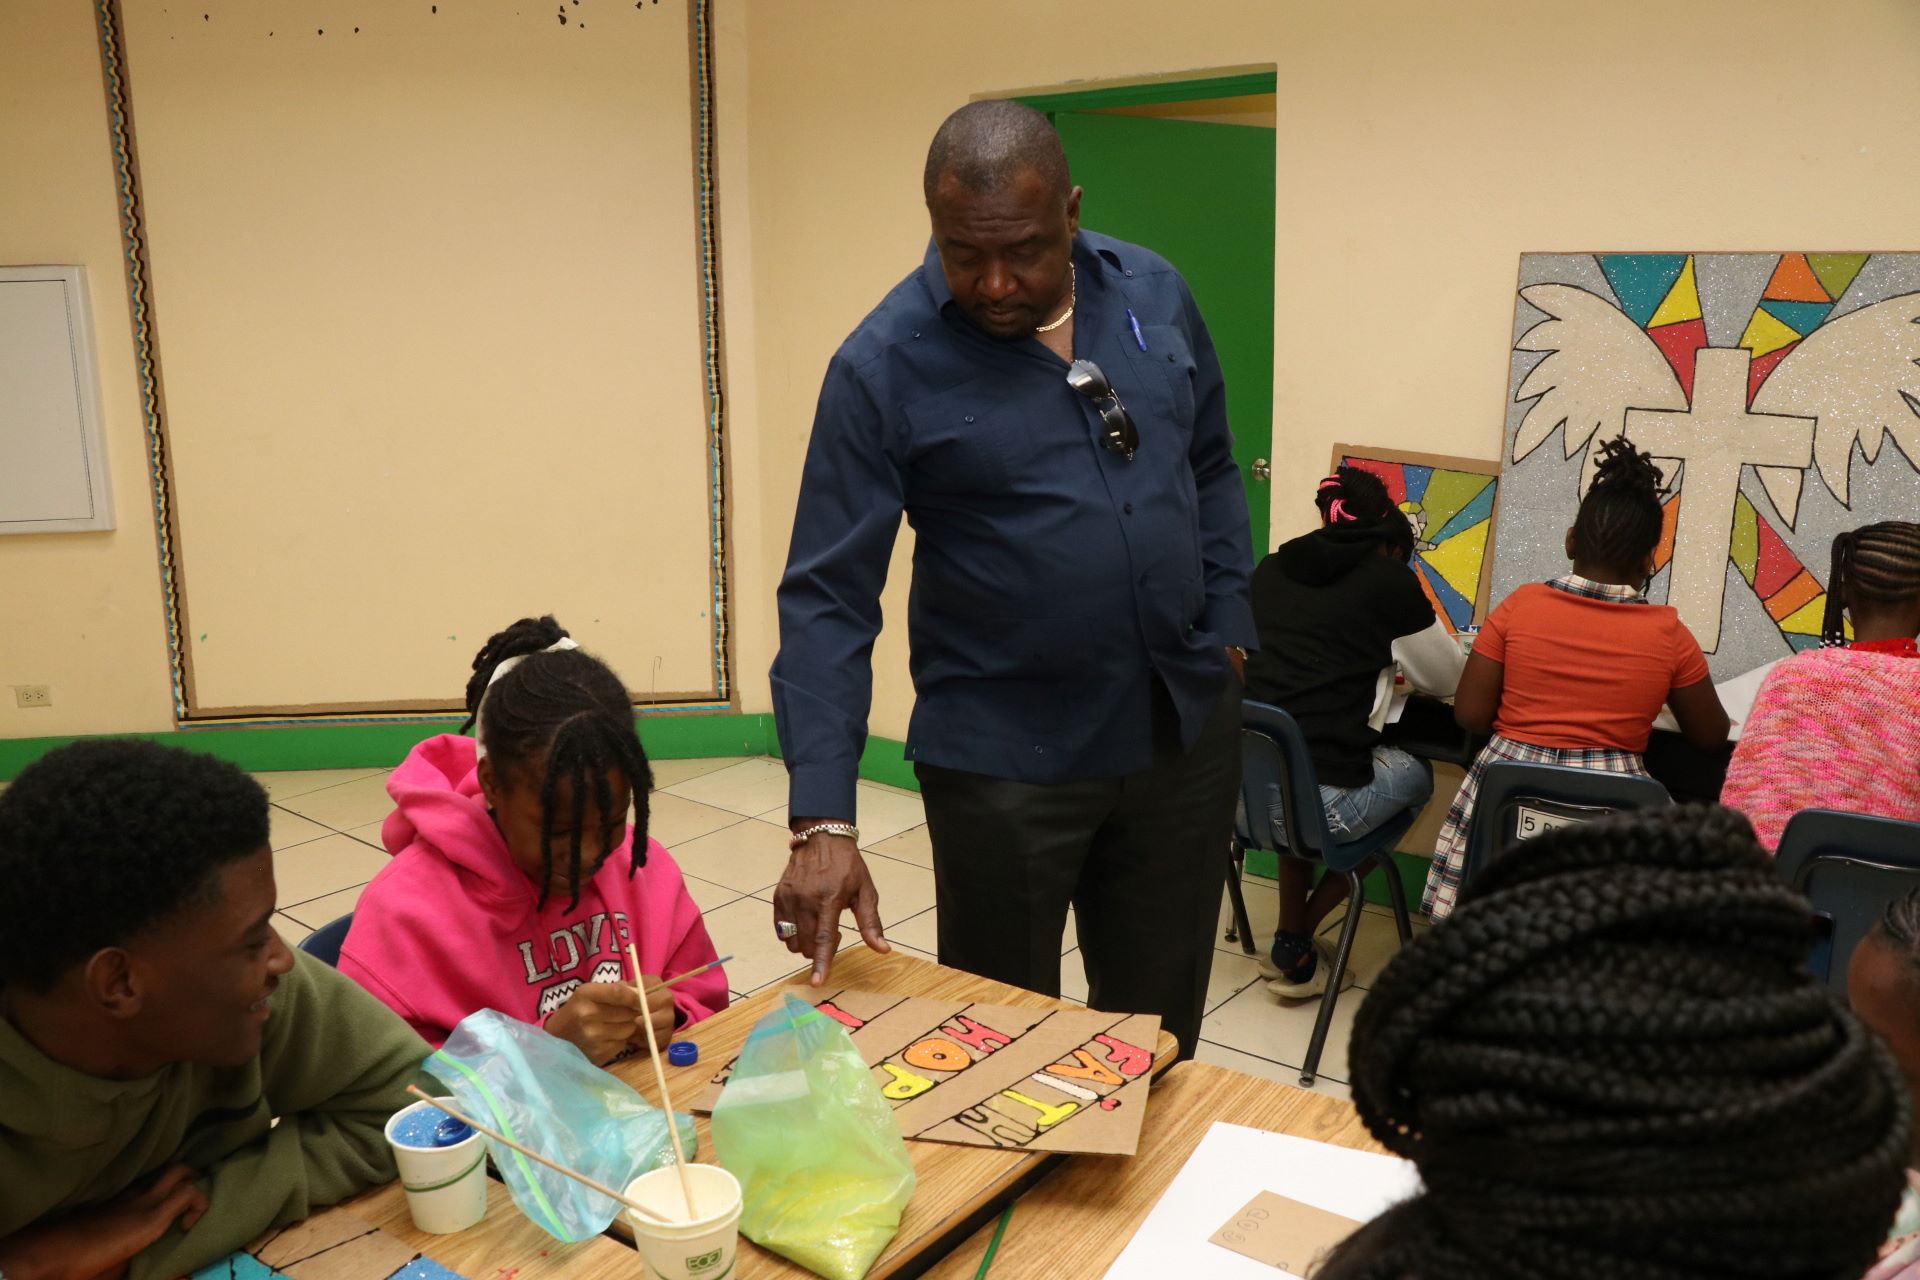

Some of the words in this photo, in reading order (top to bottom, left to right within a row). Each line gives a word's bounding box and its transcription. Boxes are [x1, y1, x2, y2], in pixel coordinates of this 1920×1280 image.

[1524, 816, 1536, 832] 5
[518, 911, 631, 983] LOVE
[878, 1015, 1014, 1100] HOP
[955, 1032, 1155, 1147] FAITH
